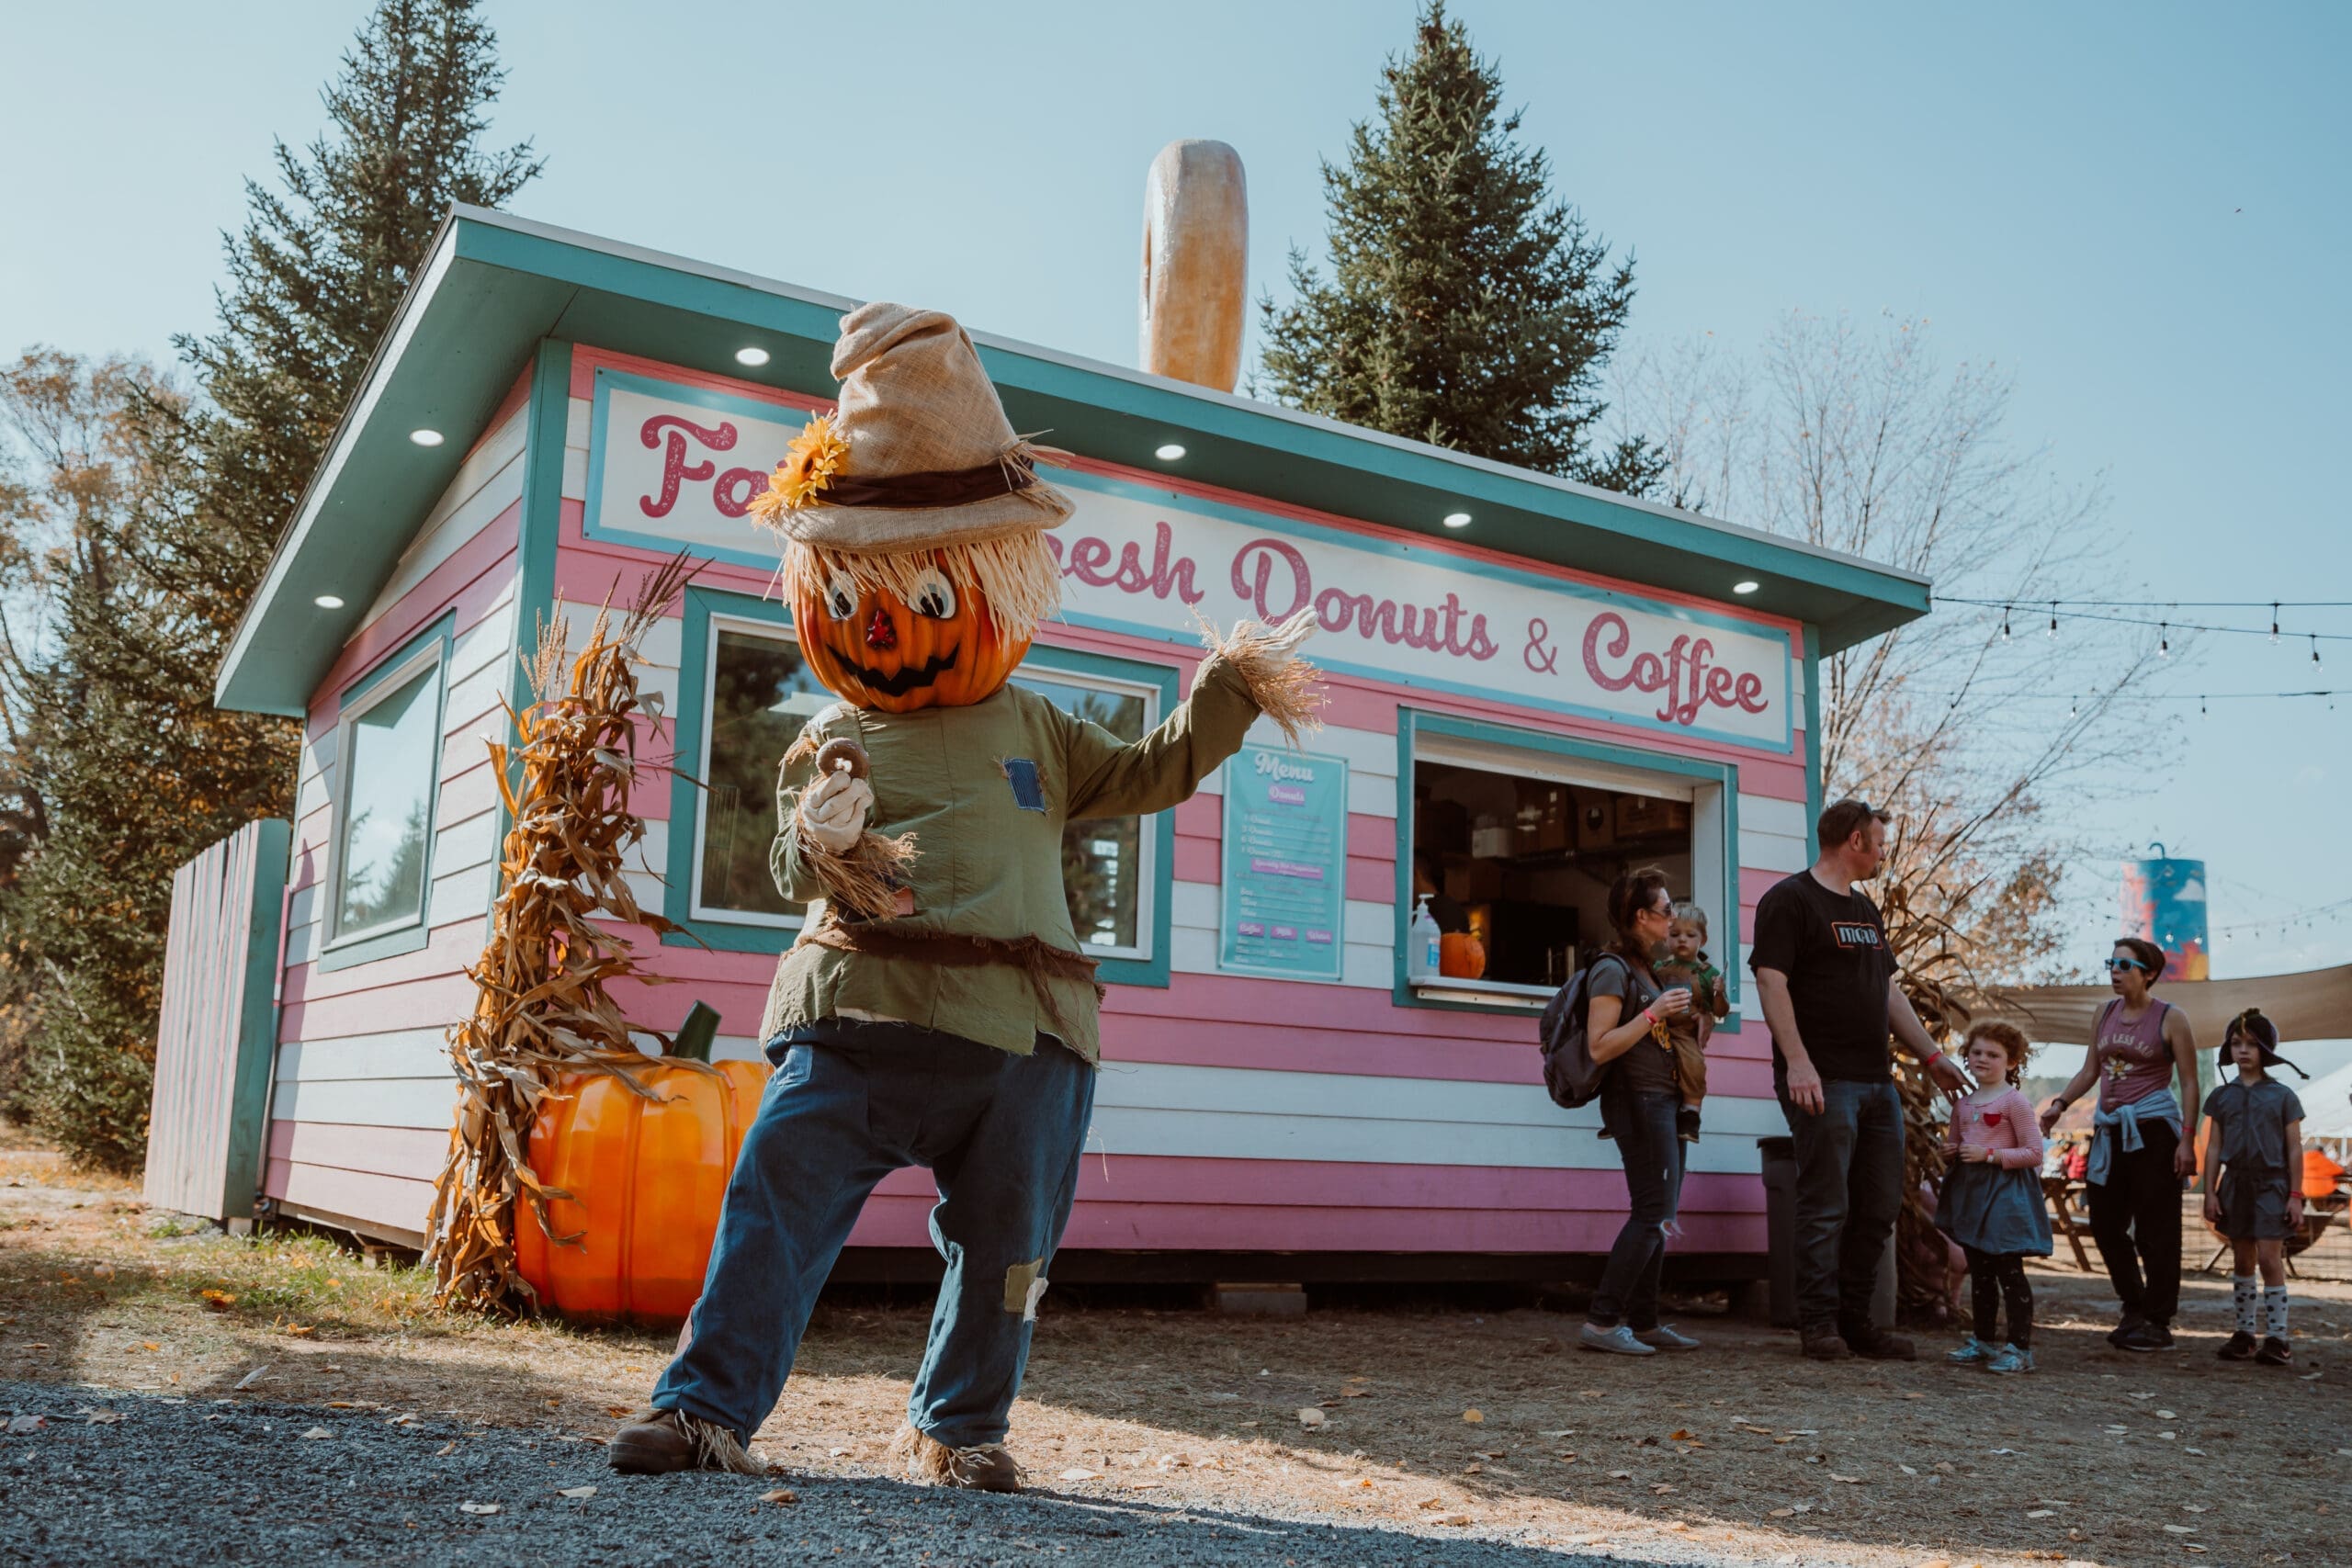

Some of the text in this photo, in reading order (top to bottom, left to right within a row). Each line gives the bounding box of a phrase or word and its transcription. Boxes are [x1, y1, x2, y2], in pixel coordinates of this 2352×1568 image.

[1231, 538, 1499, 661] Donuts
[1524, 618, 1558, 676] &
[1582, 612, 1769, 726] Coffee
[1255, 752, 1315, 783] Menu
[1268, 785, 1306, 803] Donuts
[2112, 1033, 2136, 1046] LESS
